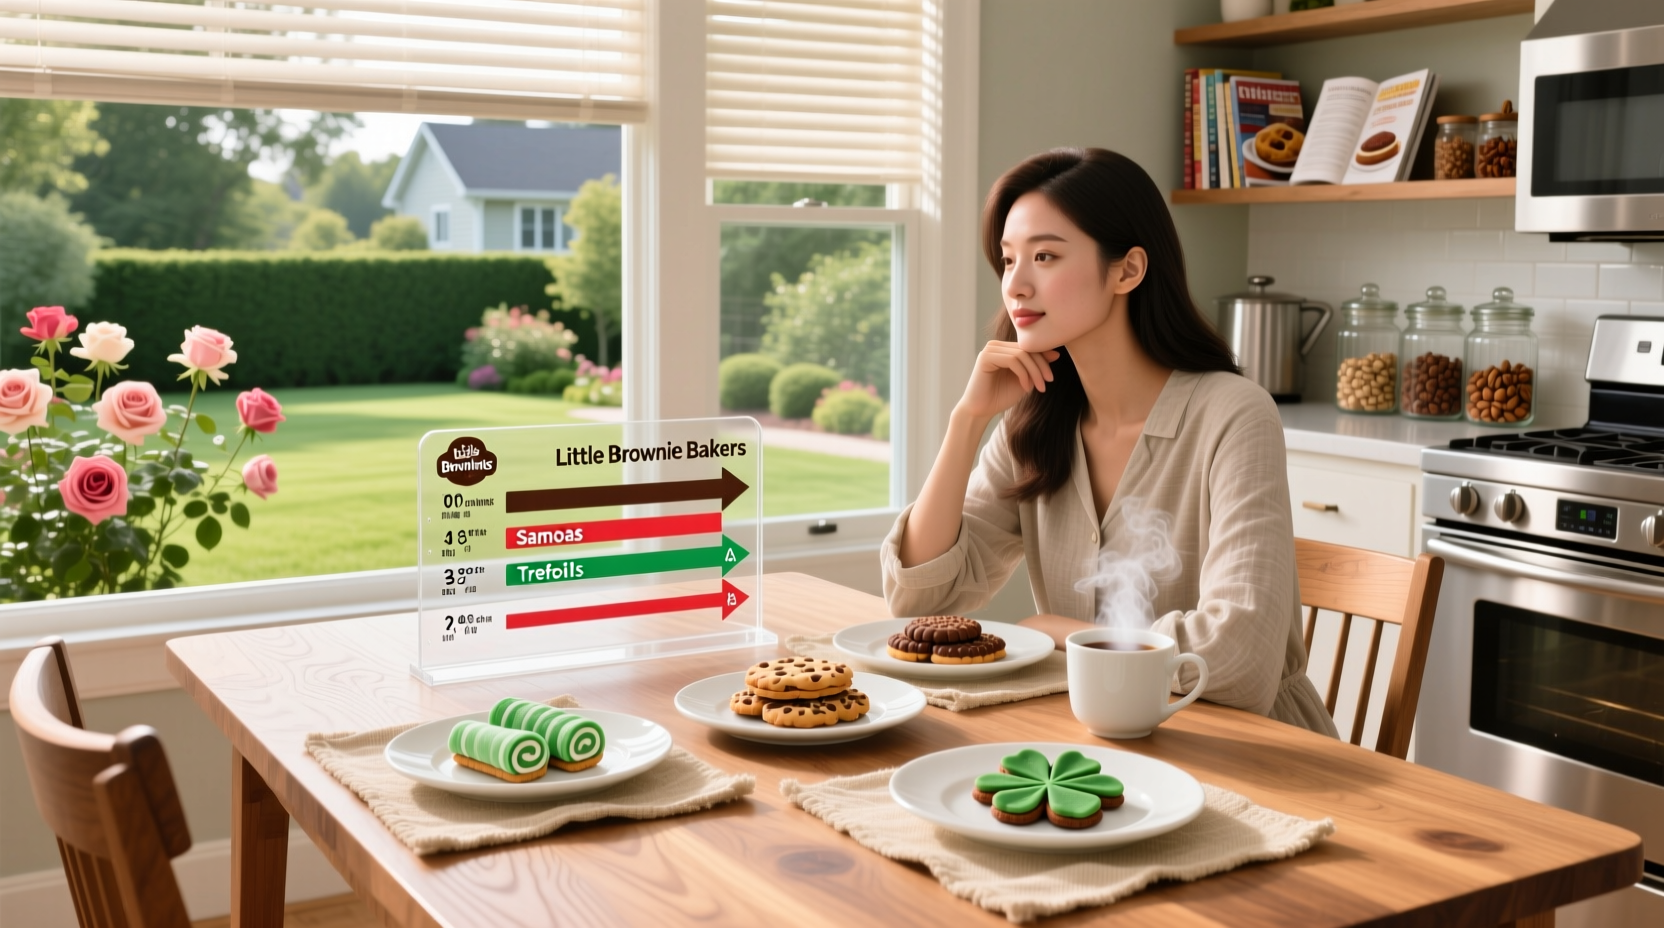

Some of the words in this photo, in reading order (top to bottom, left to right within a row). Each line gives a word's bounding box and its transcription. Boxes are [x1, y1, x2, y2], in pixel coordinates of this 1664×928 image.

[556, 446, 605, 467] Little
[608, 441, 683, 463] Brownie
[687, 439, 747, 459] Bakers
[516, 528, 584, 546] Samoas
[516, 561, 584, 583] Trefoils
